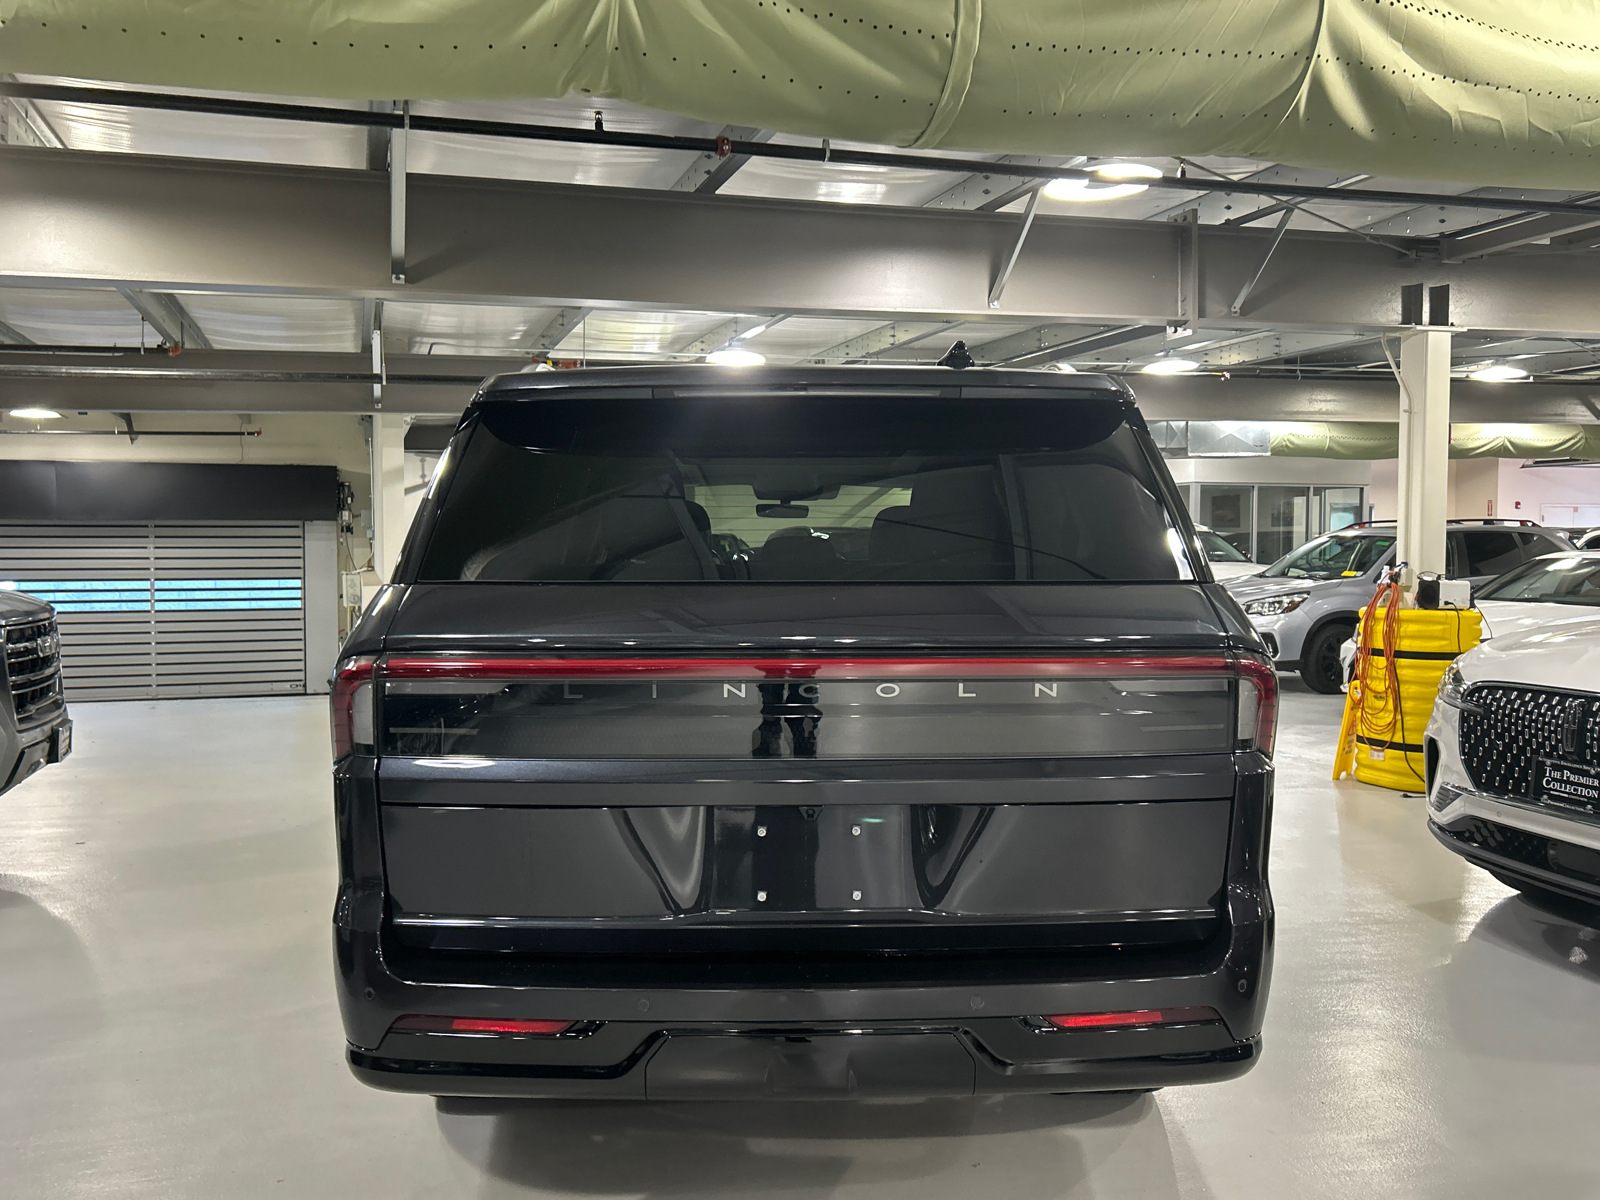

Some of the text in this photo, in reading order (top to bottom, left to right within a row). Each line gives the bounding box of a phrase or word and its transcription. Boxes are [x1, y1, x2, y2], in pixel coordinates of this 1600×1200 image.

[563, 682, 1057, 699] LINCOLN
[1544, 766, 1600, 787] THE PREMIER
[1542, 777, 1599, 799] COLLECTION
